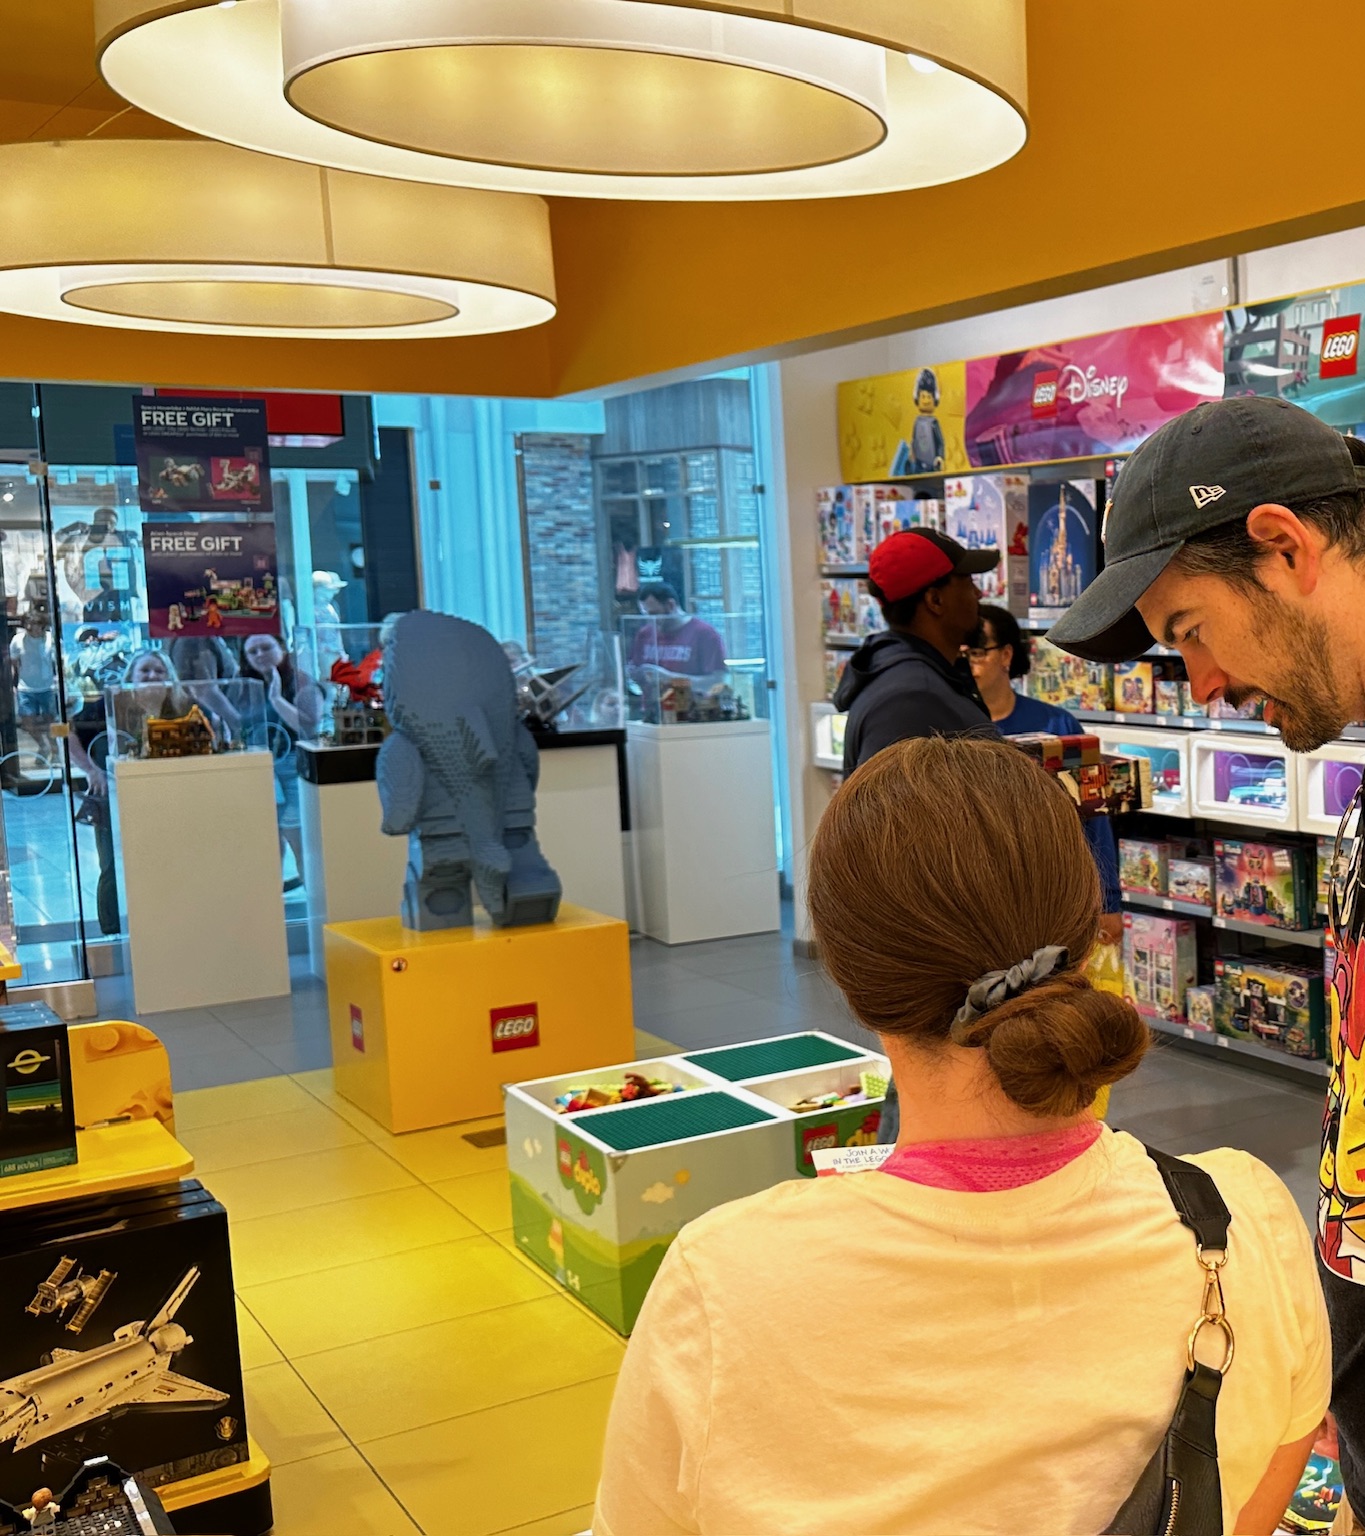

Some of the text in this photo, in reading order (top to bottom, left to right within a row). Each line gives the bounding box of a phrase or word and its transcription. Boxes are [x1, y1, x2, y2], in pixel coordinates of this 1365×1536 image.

[1323, 331, 1358, 362] LEGO
[1033, 384, 1057, 407] LEGO
[141, 411, 234, 427] FREE GIFT
[150, 536, 243, 551] FREE GIFT
[494, 1016, 535, 1039] LEGO
[805, 1135, 836, 1153] LEGO
[843, 1156, 861, 1164] THE
[846, 1149, 868, 1158] JOIN
